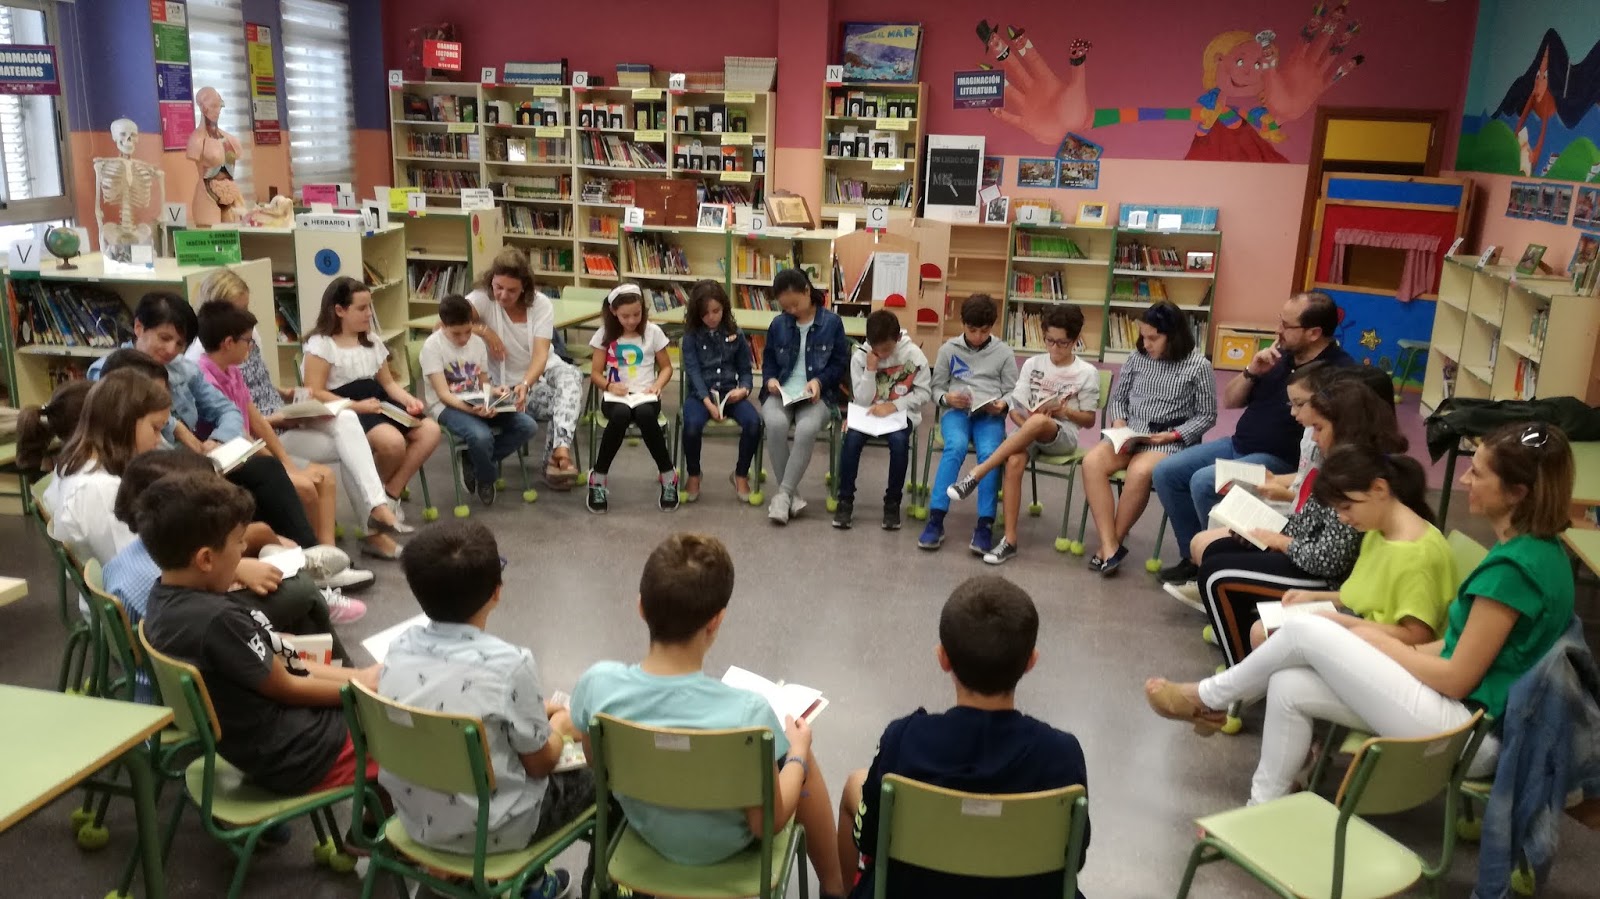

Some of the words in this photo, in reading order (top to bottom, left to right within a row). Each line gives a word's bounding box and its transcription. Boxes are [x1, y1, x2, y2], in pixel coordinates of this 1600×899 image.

[887, 27, 914, 38] MAR
[391, 72, 400, 82] Q
[485, 71, 492, 80] P
[576, 74, 584, 84] O
[830, 68, 839, 79] N
[158, 74, 164, 88] 6
[957, 75, 1001, 86] IMAGINACIÓN
[960, 86, 998, 95] LITERATURA
[342, 195, 350, 206] T
[412, 196, 421, 207] T
[169, 207, 181, 221] V
[630, 211, 638, 223] E
[872, 207, 883, 221] C
[1025, 209, 1033, 220] J
[752, 218, 762, 230] D
[16, 244, 33, 264] V
[323, 255, 332, 268] 6
